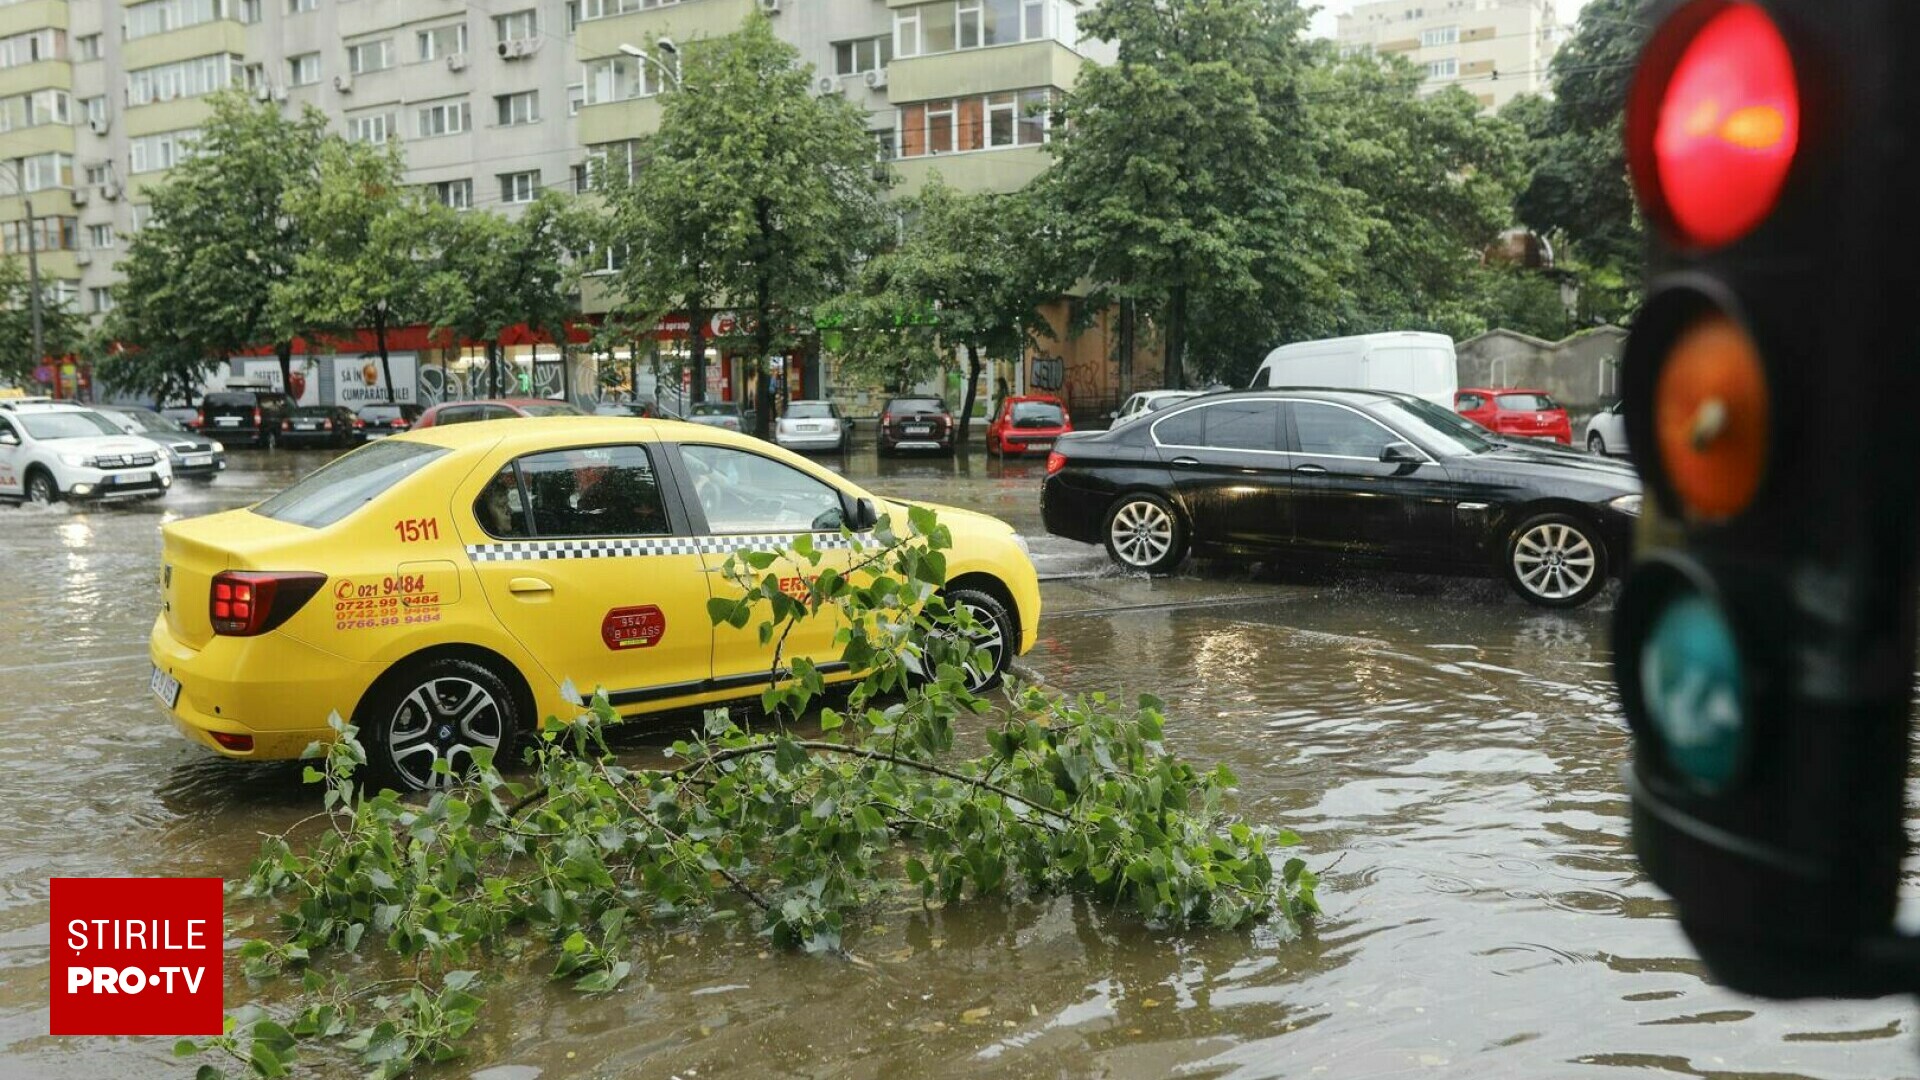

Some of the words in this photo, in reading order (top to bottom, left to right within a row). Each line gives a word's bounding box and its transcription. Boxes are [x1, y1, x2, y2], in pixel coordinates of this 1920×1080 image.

[342, 387, 409, 401] CUMPĂRĂTUILE!
[395, 517, 439, 543] 1511
[358, 584, 378, 597] 021
[383, 575, 425, 594] 9484
[335, 598, 398, 611] 0722.99
[403, 595, 439, 604] 9484
[336, 617, 399, 630] 0766.99
[404, 613, 441, 624] 9484
